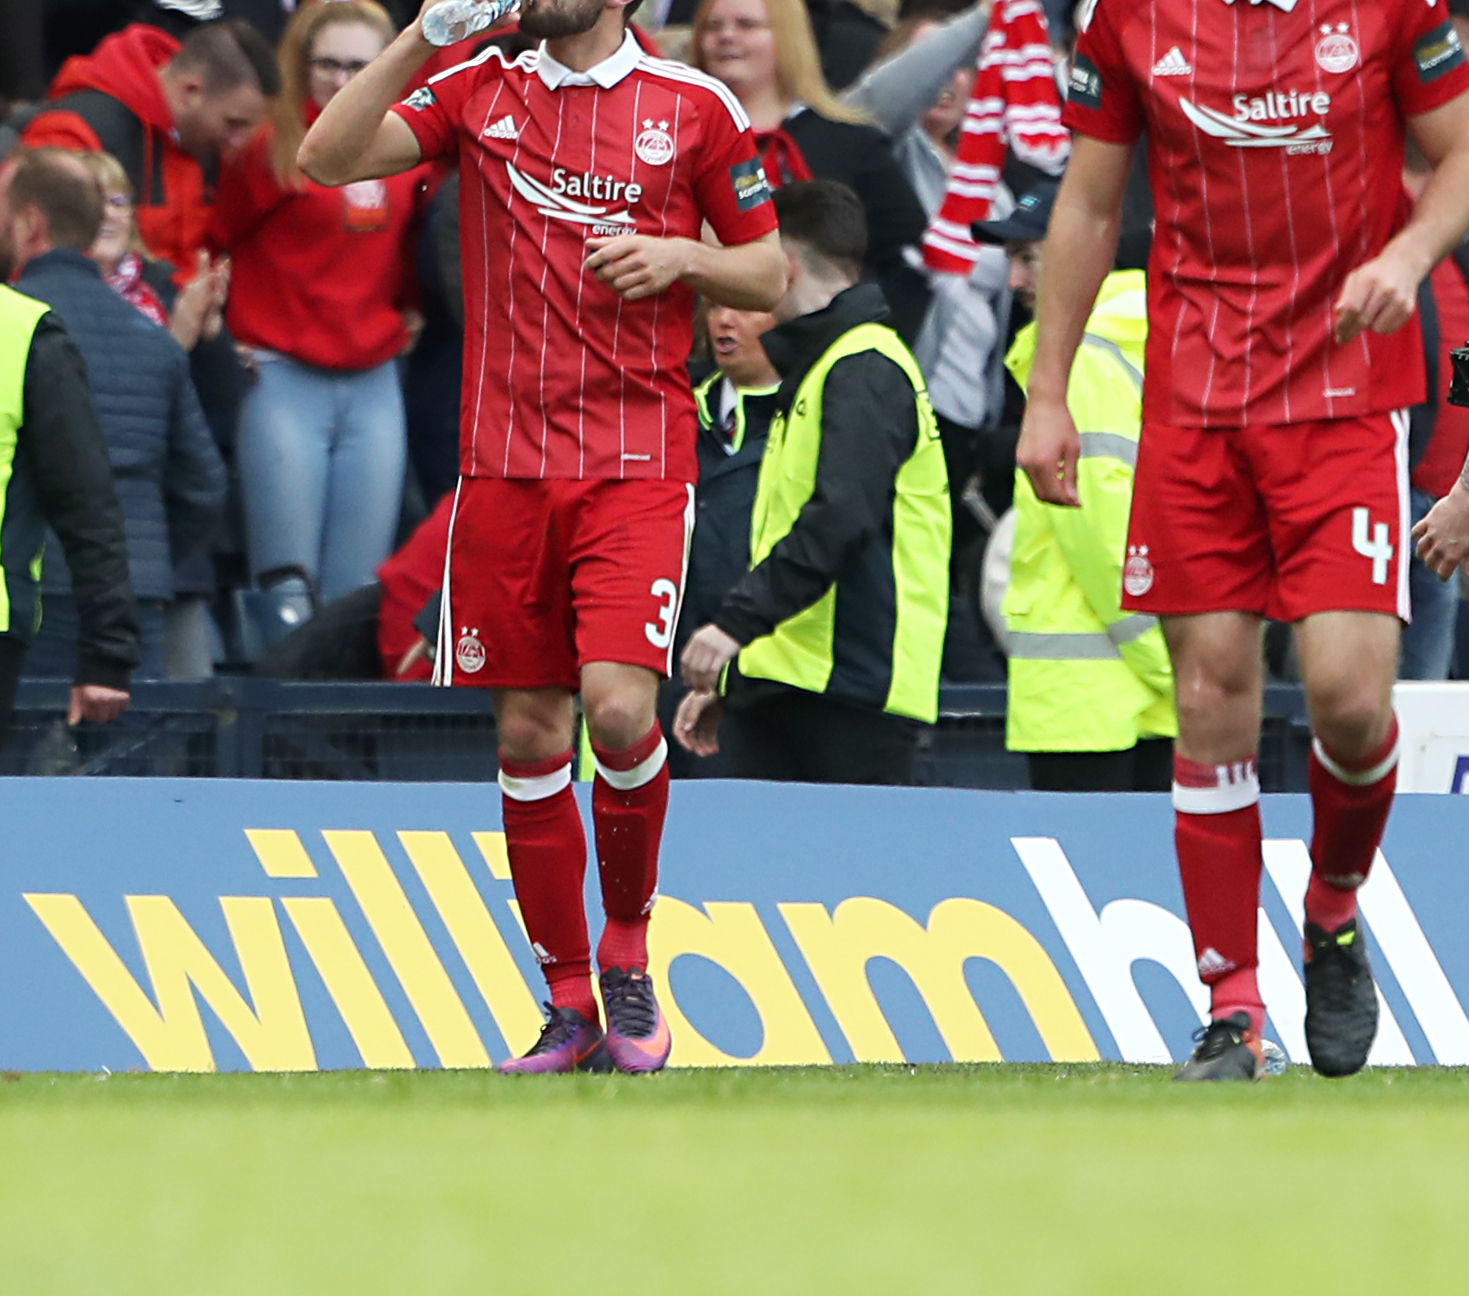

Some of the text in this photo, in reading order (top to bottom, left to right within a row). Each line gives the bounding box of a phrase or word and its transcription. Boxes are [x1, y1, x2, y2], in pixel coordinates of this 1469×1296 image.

[1152, 65, 1192, 77] adidas
[1233, 89, 1331, 122] Saltire
[484, 128, 519, 139] adidas
[1286, 140, 1333, 156] energy
[552, 169, 643, 203] Saltire
[1352, 506, 1394, 585] 4
[645, 578, 677, 649] 3
